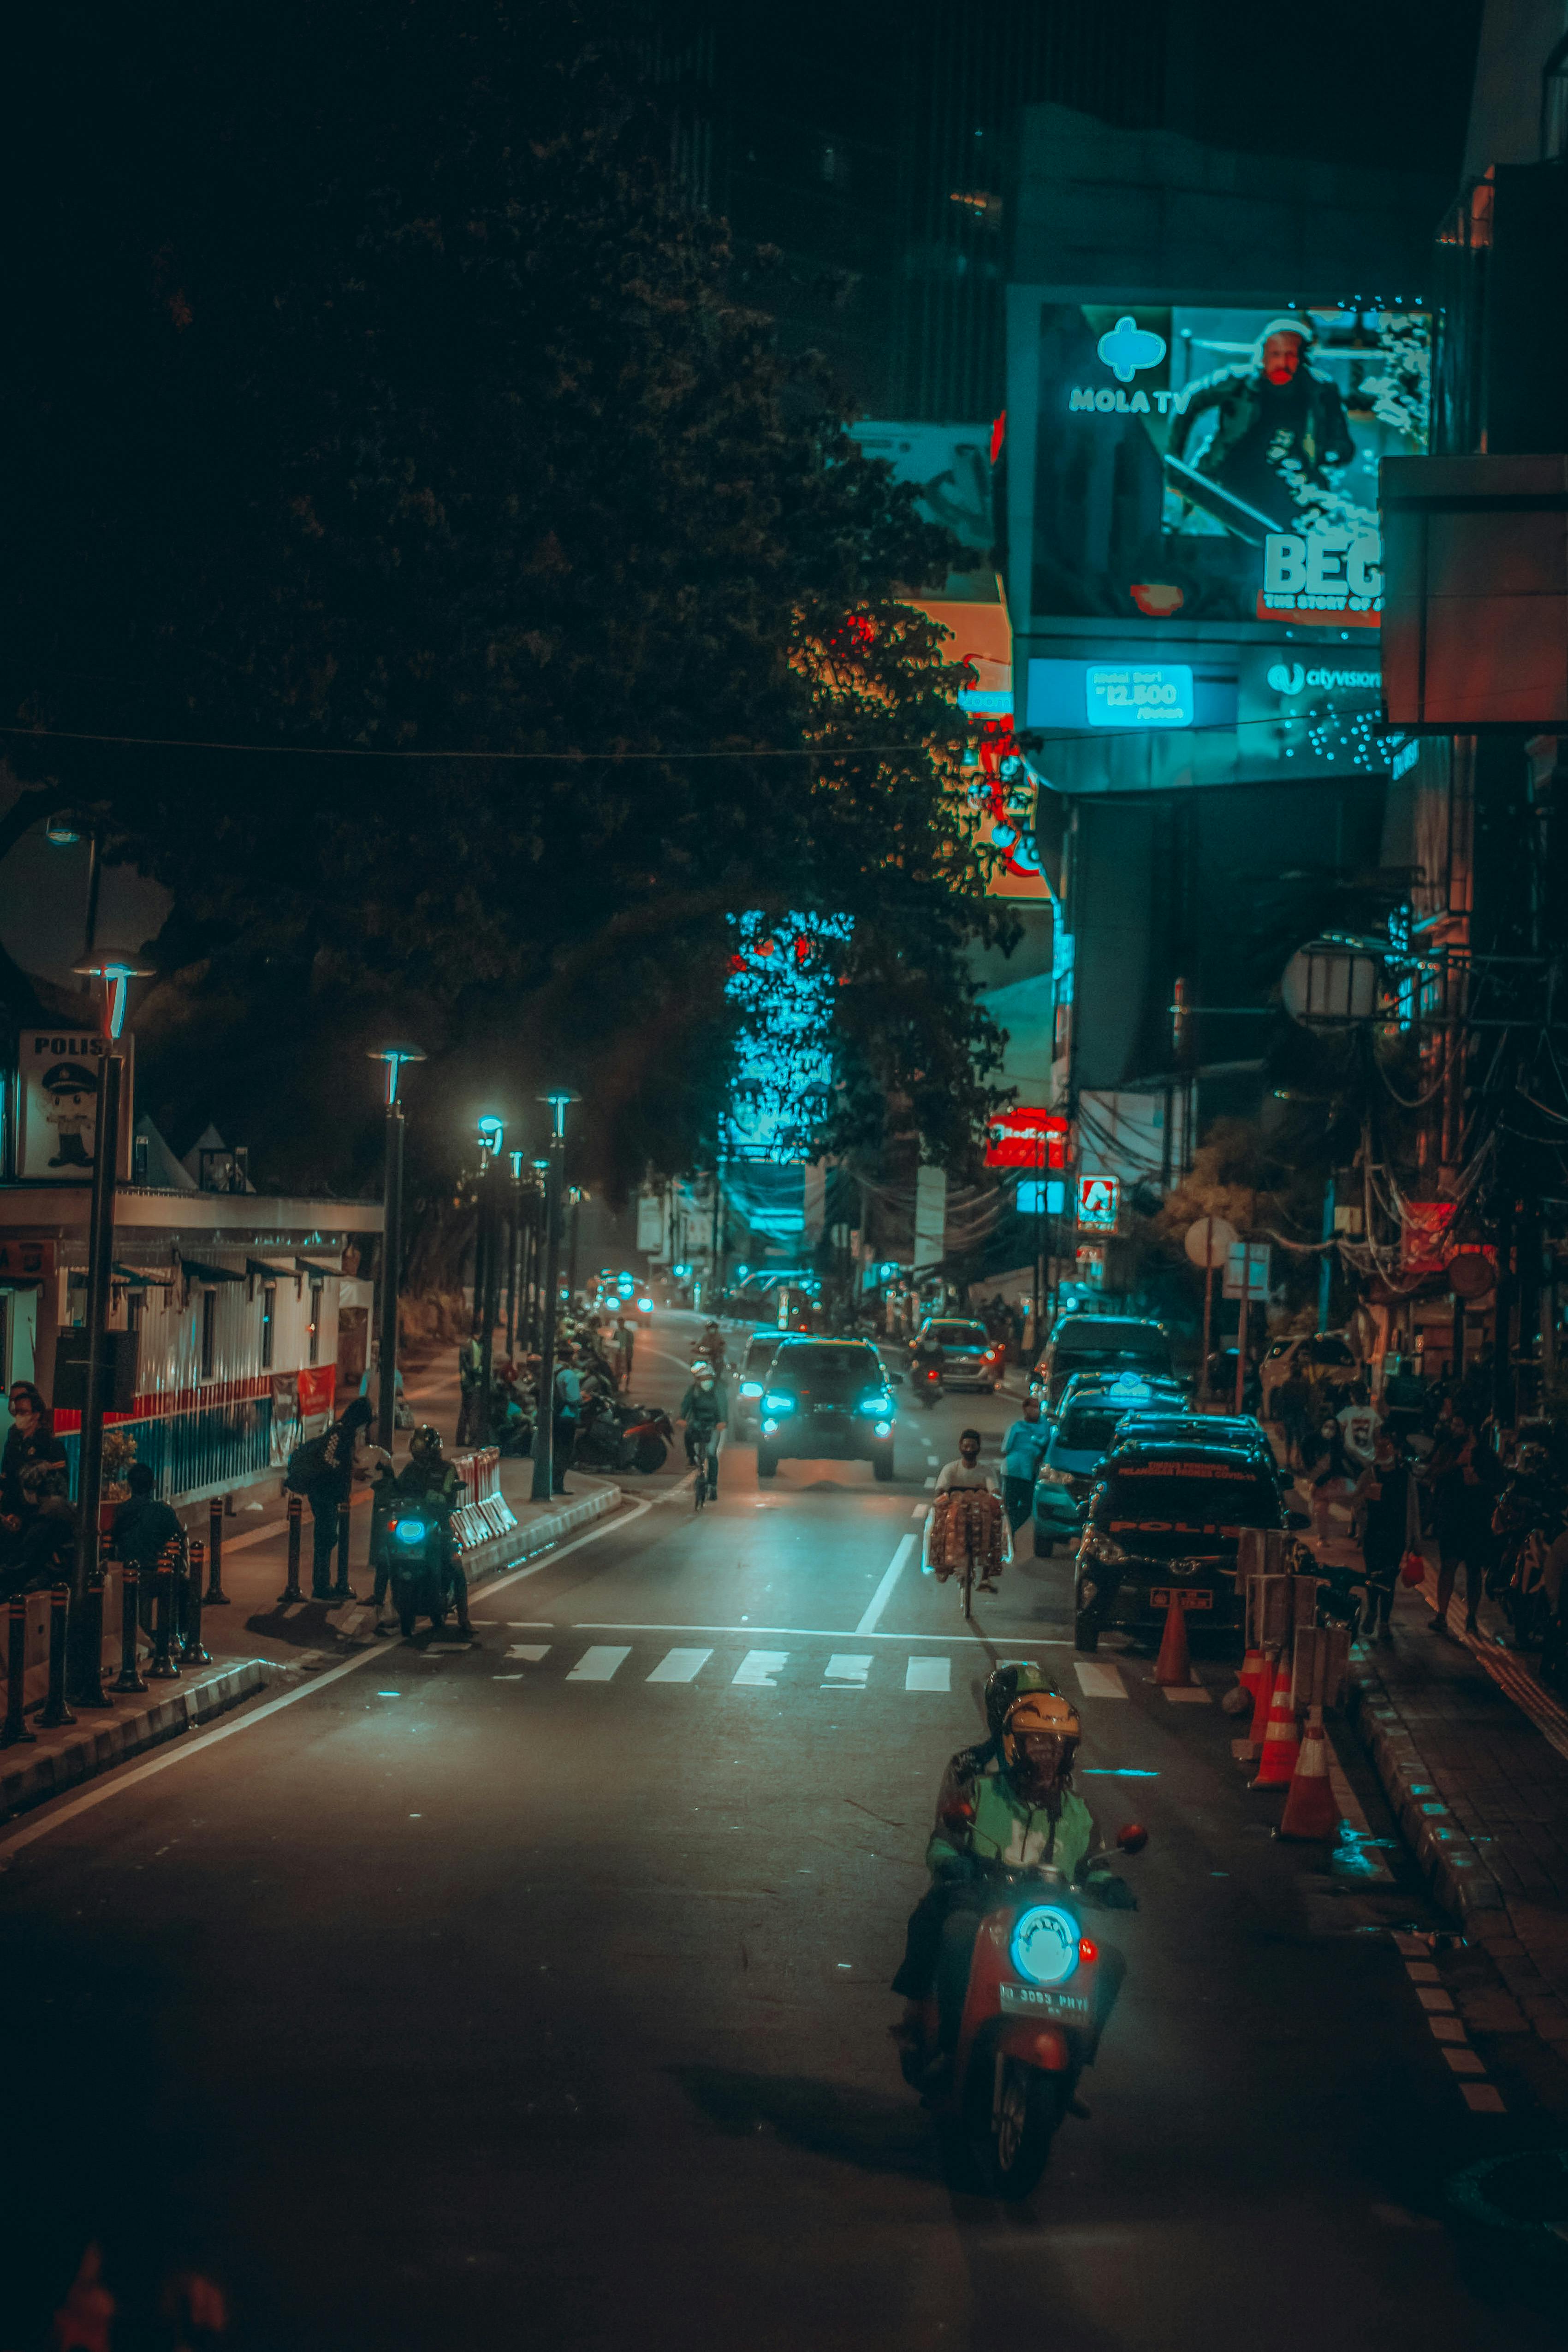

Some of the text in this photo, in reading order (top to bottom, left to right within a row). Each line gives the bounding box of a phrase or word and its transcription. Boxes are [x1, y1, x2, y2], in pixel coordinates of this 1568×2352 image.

[1069, 388, 1191, 414] MOLA TV
[35, 1037, 103, 1055] POLIS
[1109, 1521, 1240, 1538] POLIS
